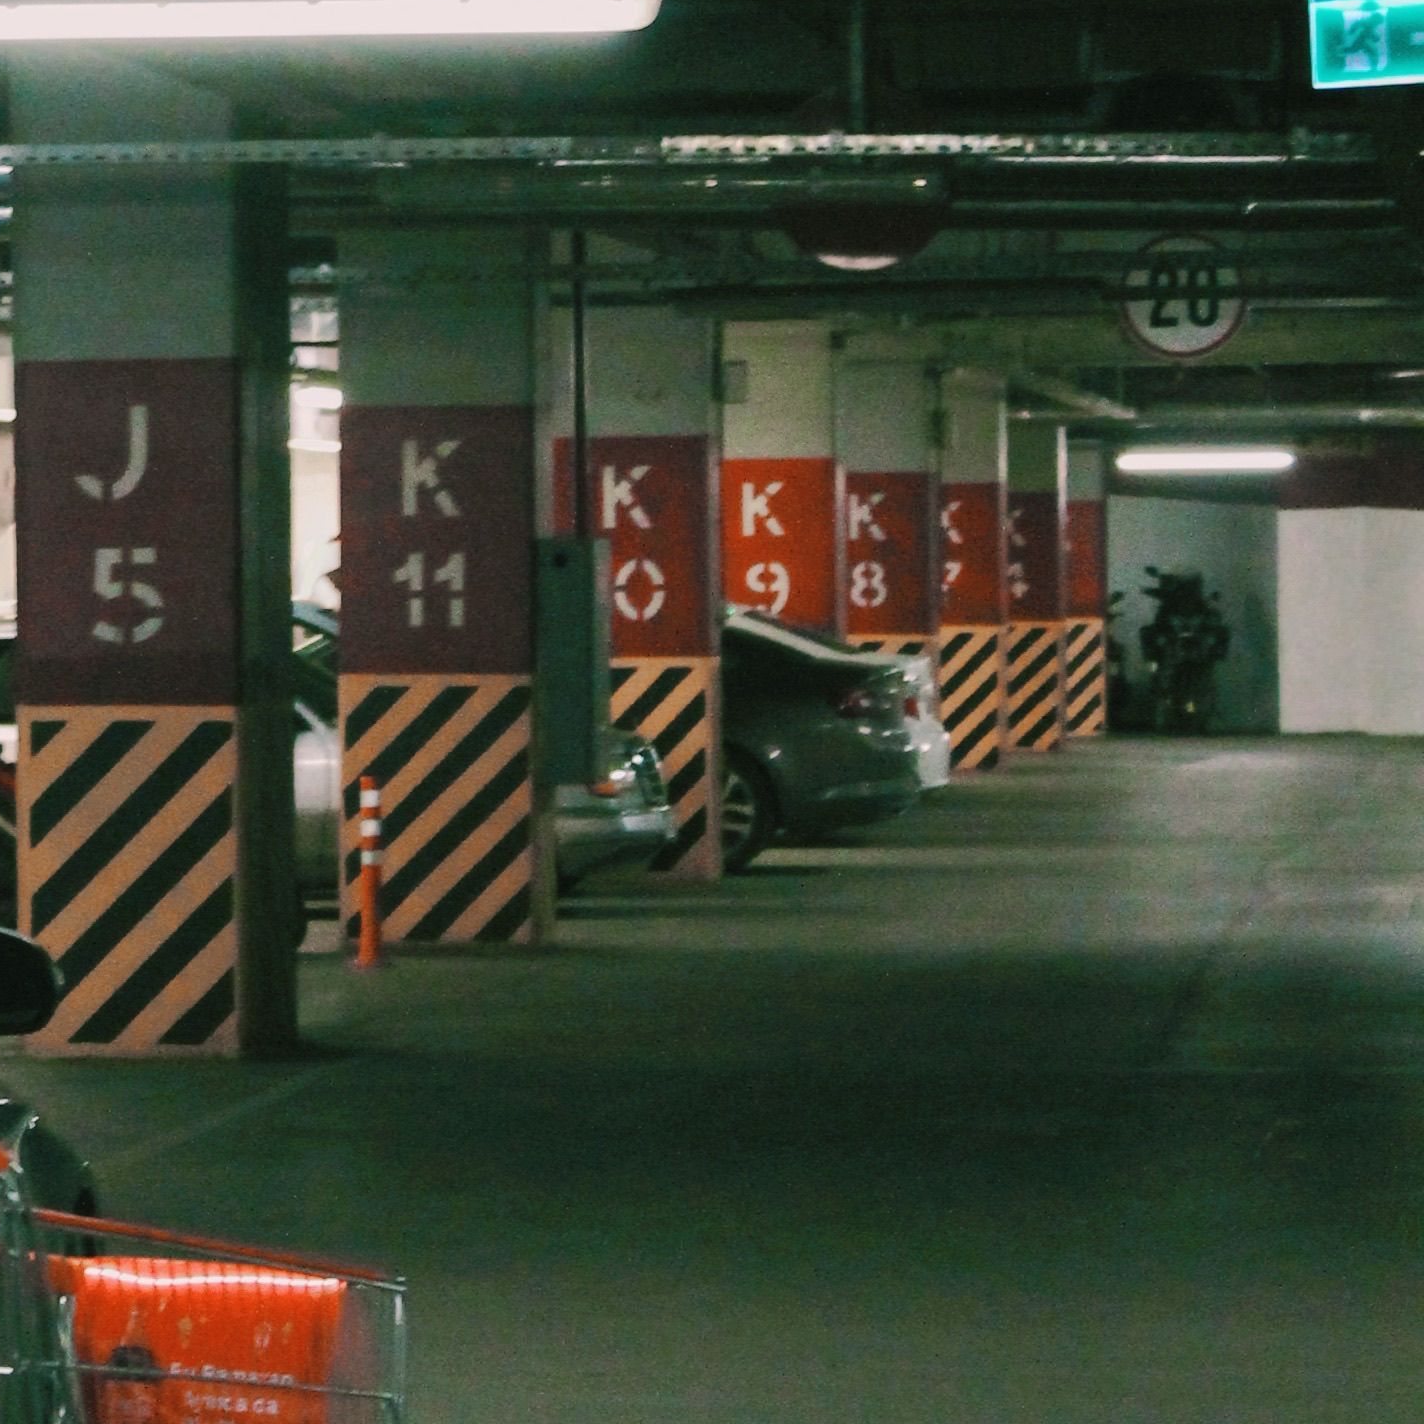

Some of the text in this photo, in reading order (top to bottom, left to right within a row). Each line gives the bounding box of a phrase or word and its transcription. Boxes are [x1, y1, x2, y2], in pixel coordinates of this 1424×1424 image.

[1149, 261, 1219, 328] 20
[76, 405, 149, 500] J
[401, 440, 462, 517] K
[602, 465, 651, 529] K
[741, 480, 784, 536] K
[849, 491, 886, 540] K
[92, 548, 164, 644] 5
[393, 552, 466, 627] 11
[745, 561, 791, 616] 9
[851, 561, 887, 608] 8
